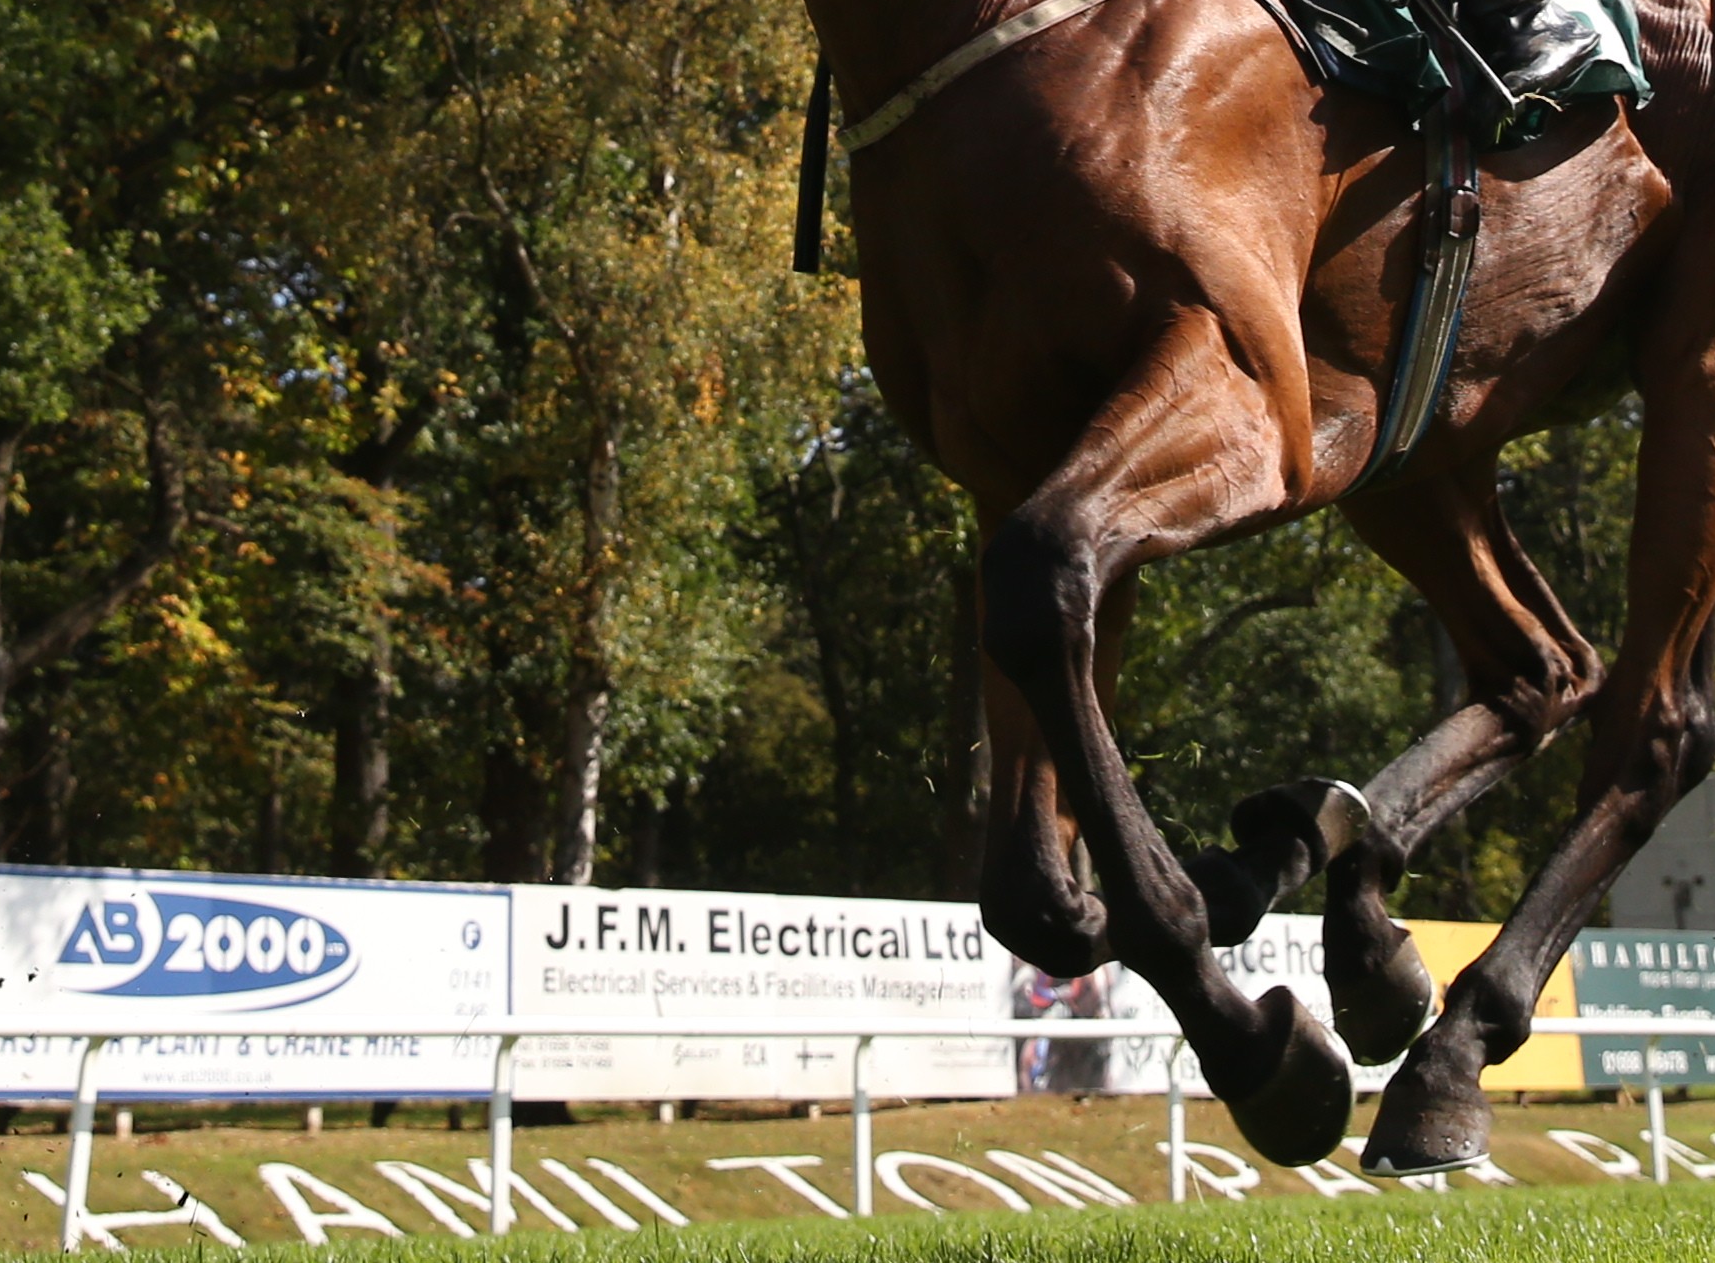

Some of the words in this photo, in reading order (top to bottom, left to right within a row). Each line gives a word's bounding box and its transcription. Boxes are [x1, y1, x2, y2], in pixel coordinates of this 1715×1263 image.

[56, 897, 146, 966] AB
[165, 913, 326, 974] 2000
[545, 902, 687, 953] J.F.M.
[707, 906, 911, 961] Electrical
[922, 915, 984, 962] Ltd
[542, 966, 646, 995] Electrical
[653, 967, 743, 997] Services
[749, 969, 760, 997] &
[764, 970, 856, 999] Facilities
[861, 974, 986, 1007] Management
[68, 1036, 125, 1056] FR
[135, 1036, 221, 1057] PLANT
[264, 1036, 352, 1057] CRANE
[363, 1036, 422, 1058] HIRE
